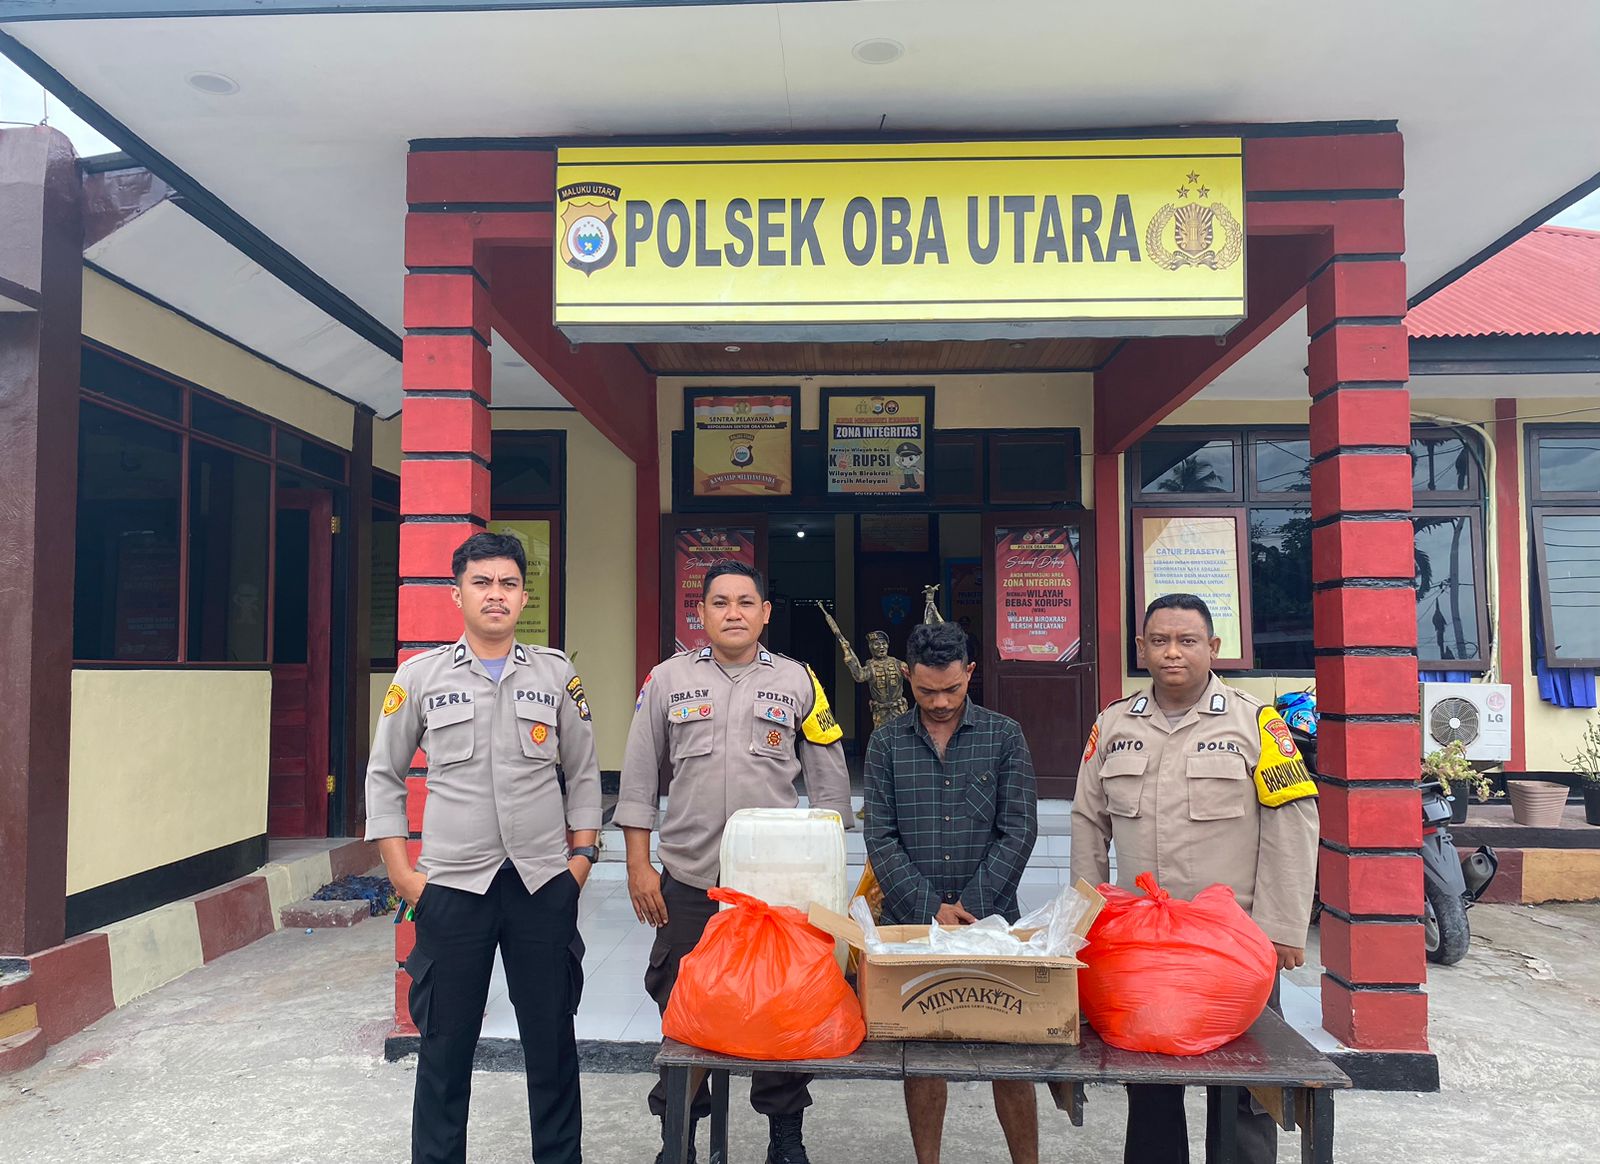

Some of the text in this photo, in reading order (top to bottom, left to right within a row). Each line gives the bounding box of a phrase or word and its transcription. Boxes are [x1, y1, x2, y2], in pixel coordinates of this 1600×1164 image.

[561, 185, 616, 198] MALUKU UTARA
[624, 193, 1142, 268] POLSEK OBA UTARA
[836, 426, 918, 438] ZONA INTEGRITAS
[1003, 579, 1072, 587] ZONA INTEGRITAS
[1026, 590, 1063, 598] WILAYAH
[1005, 598, 1071, 607] BEBAS KORUPSI
[429, 692, 472, 710] IZRL
[516, 690, 555, 707] POLRI
[757, 691, 794, 707] POLRI
[1488, 714, 1503, 723] LG
[1111, 740, 1143, 753] ANTO
